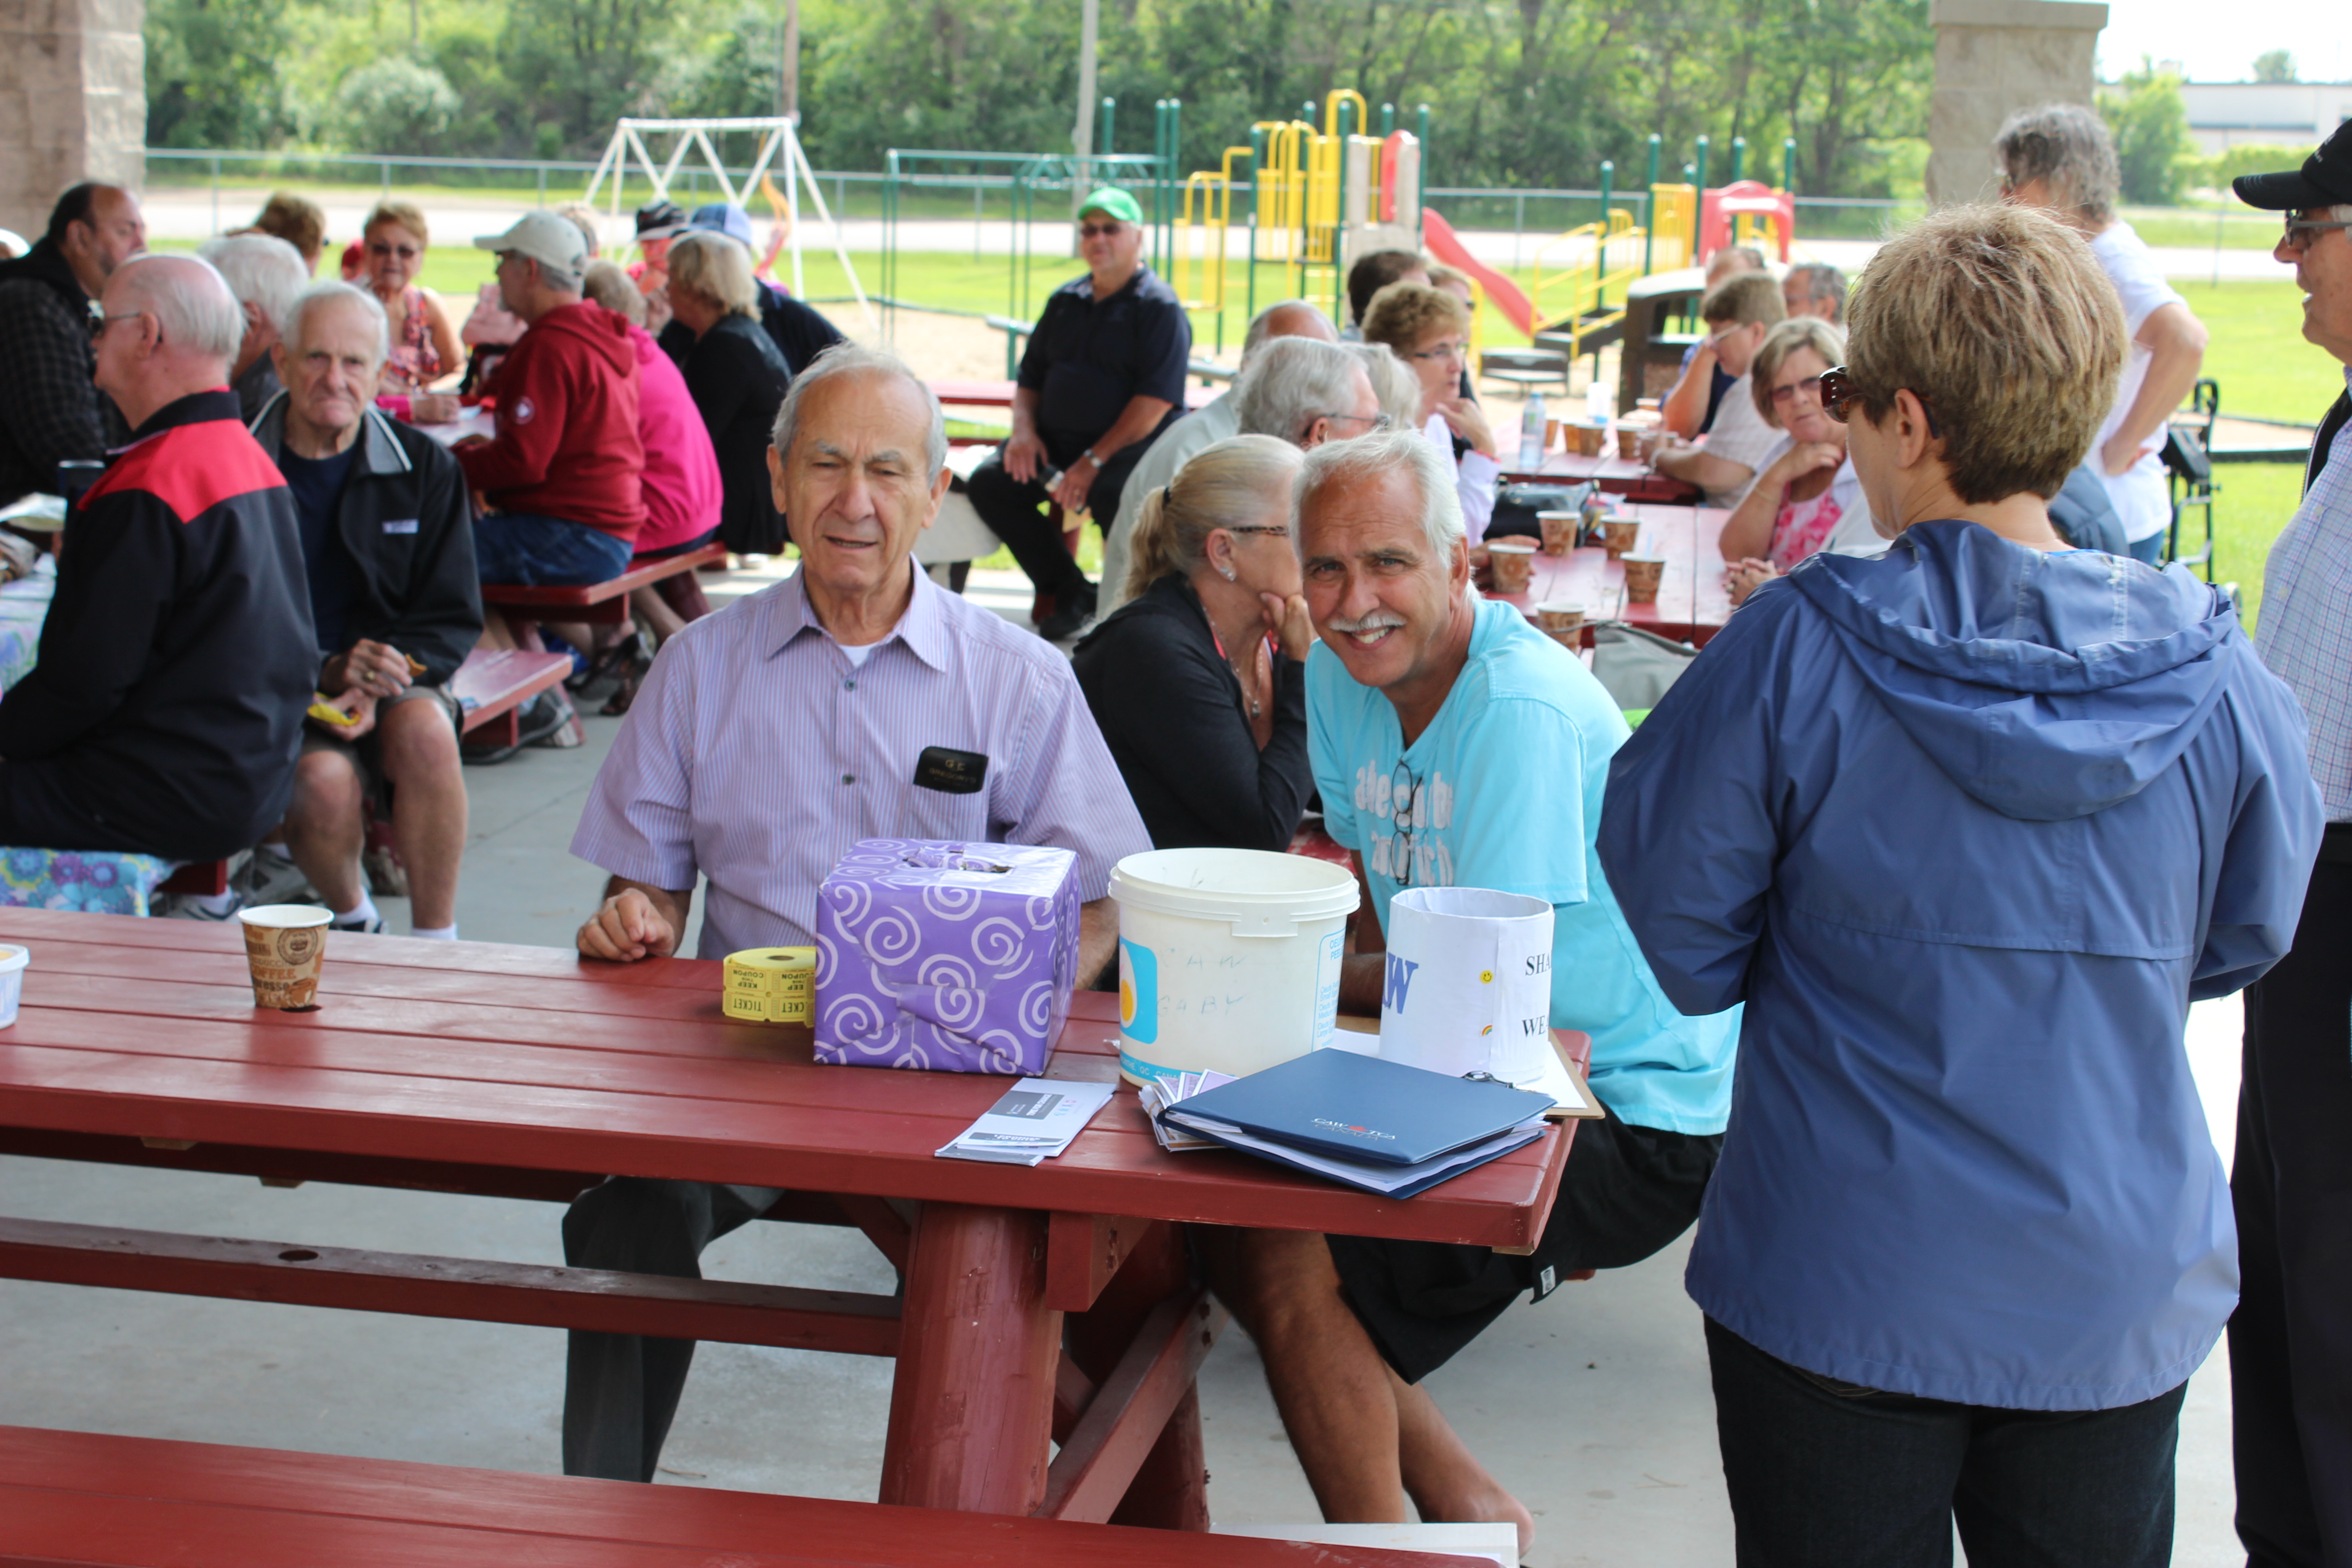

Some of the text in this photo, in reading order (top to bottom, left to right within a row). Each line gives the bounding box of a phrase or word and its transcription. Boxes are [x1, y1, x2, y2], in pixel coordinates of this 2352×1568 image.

[733, 970, 764, 978] COUPON
[733, 998, 761, 1011] TICKET
[782, 1002, 804, 1013] CKET
[1521, 1015, 1550, 1038] WE
[1140, 1066, 1150, 1076] QC
